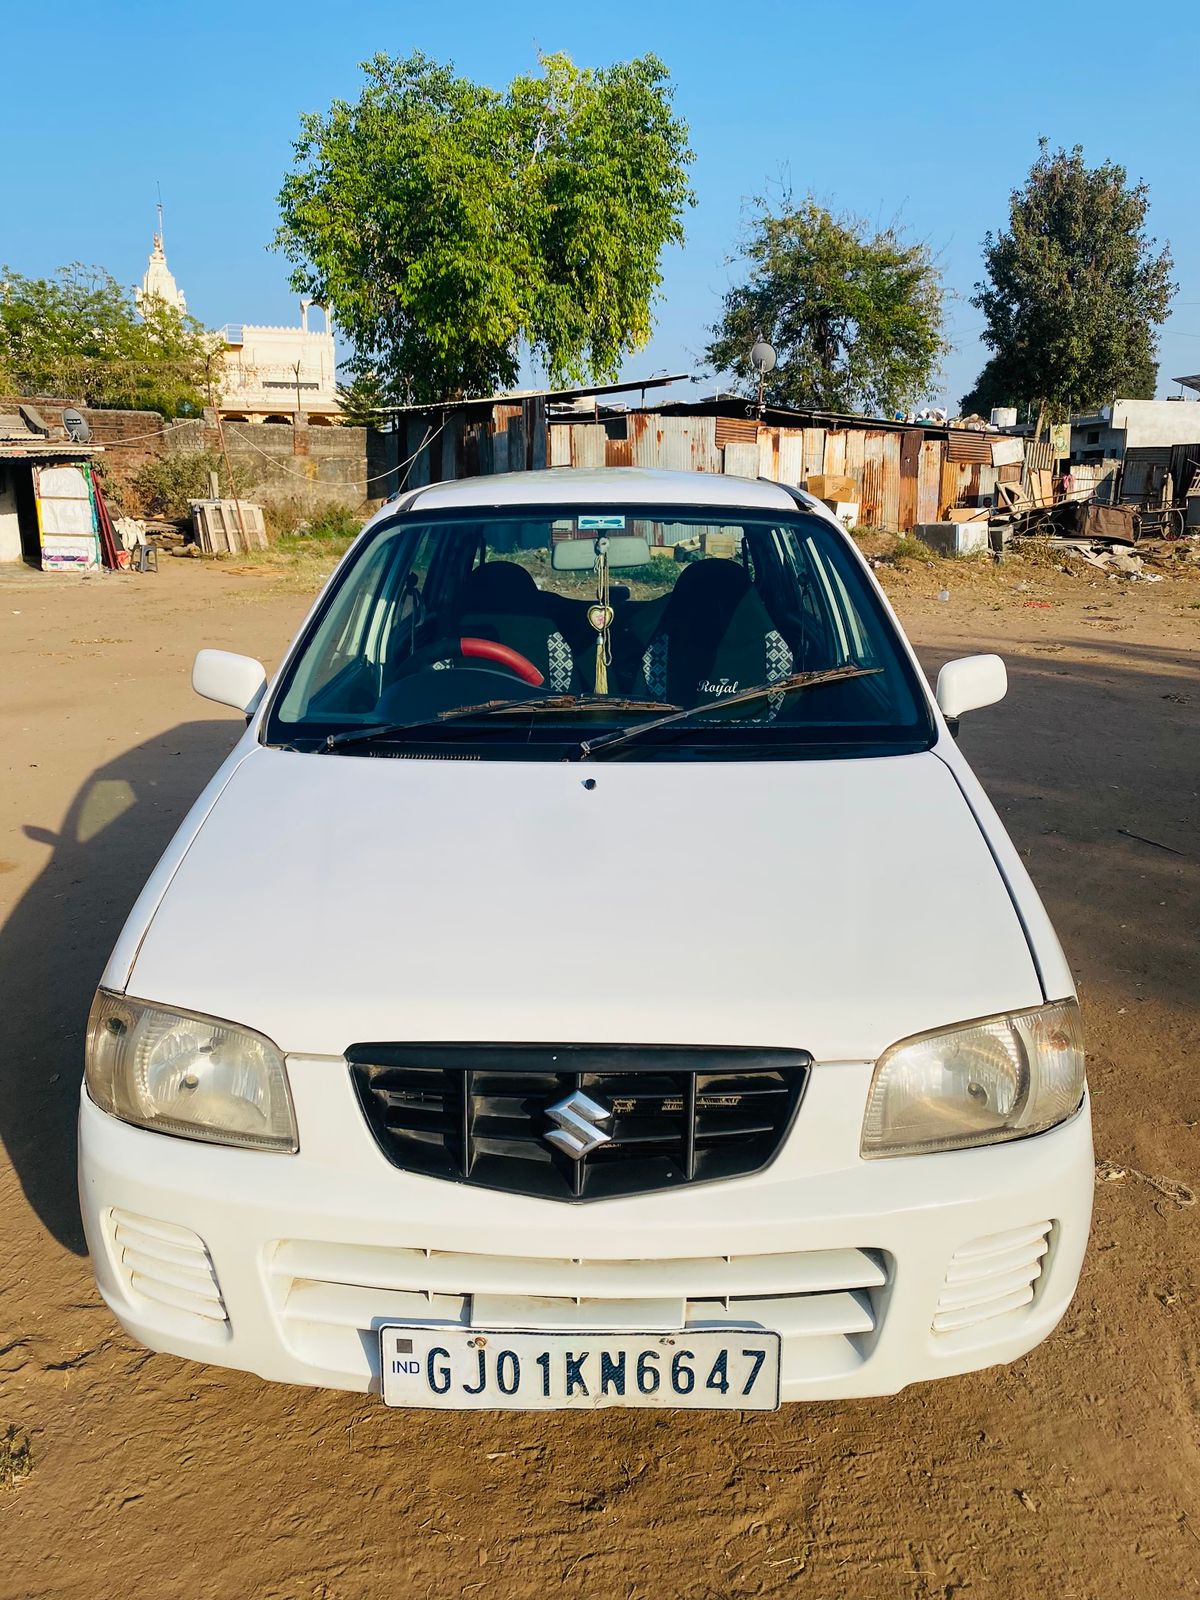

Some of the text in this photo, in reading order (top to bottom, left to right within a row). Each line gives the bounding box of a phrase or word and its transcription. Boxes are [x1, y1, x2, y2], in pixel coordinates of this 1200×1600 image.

[697, 680, 739, 697] Royal
[392, 1360, 420, 1374] IND
[427, 1347, 766, 1396] GJ01KN6647
